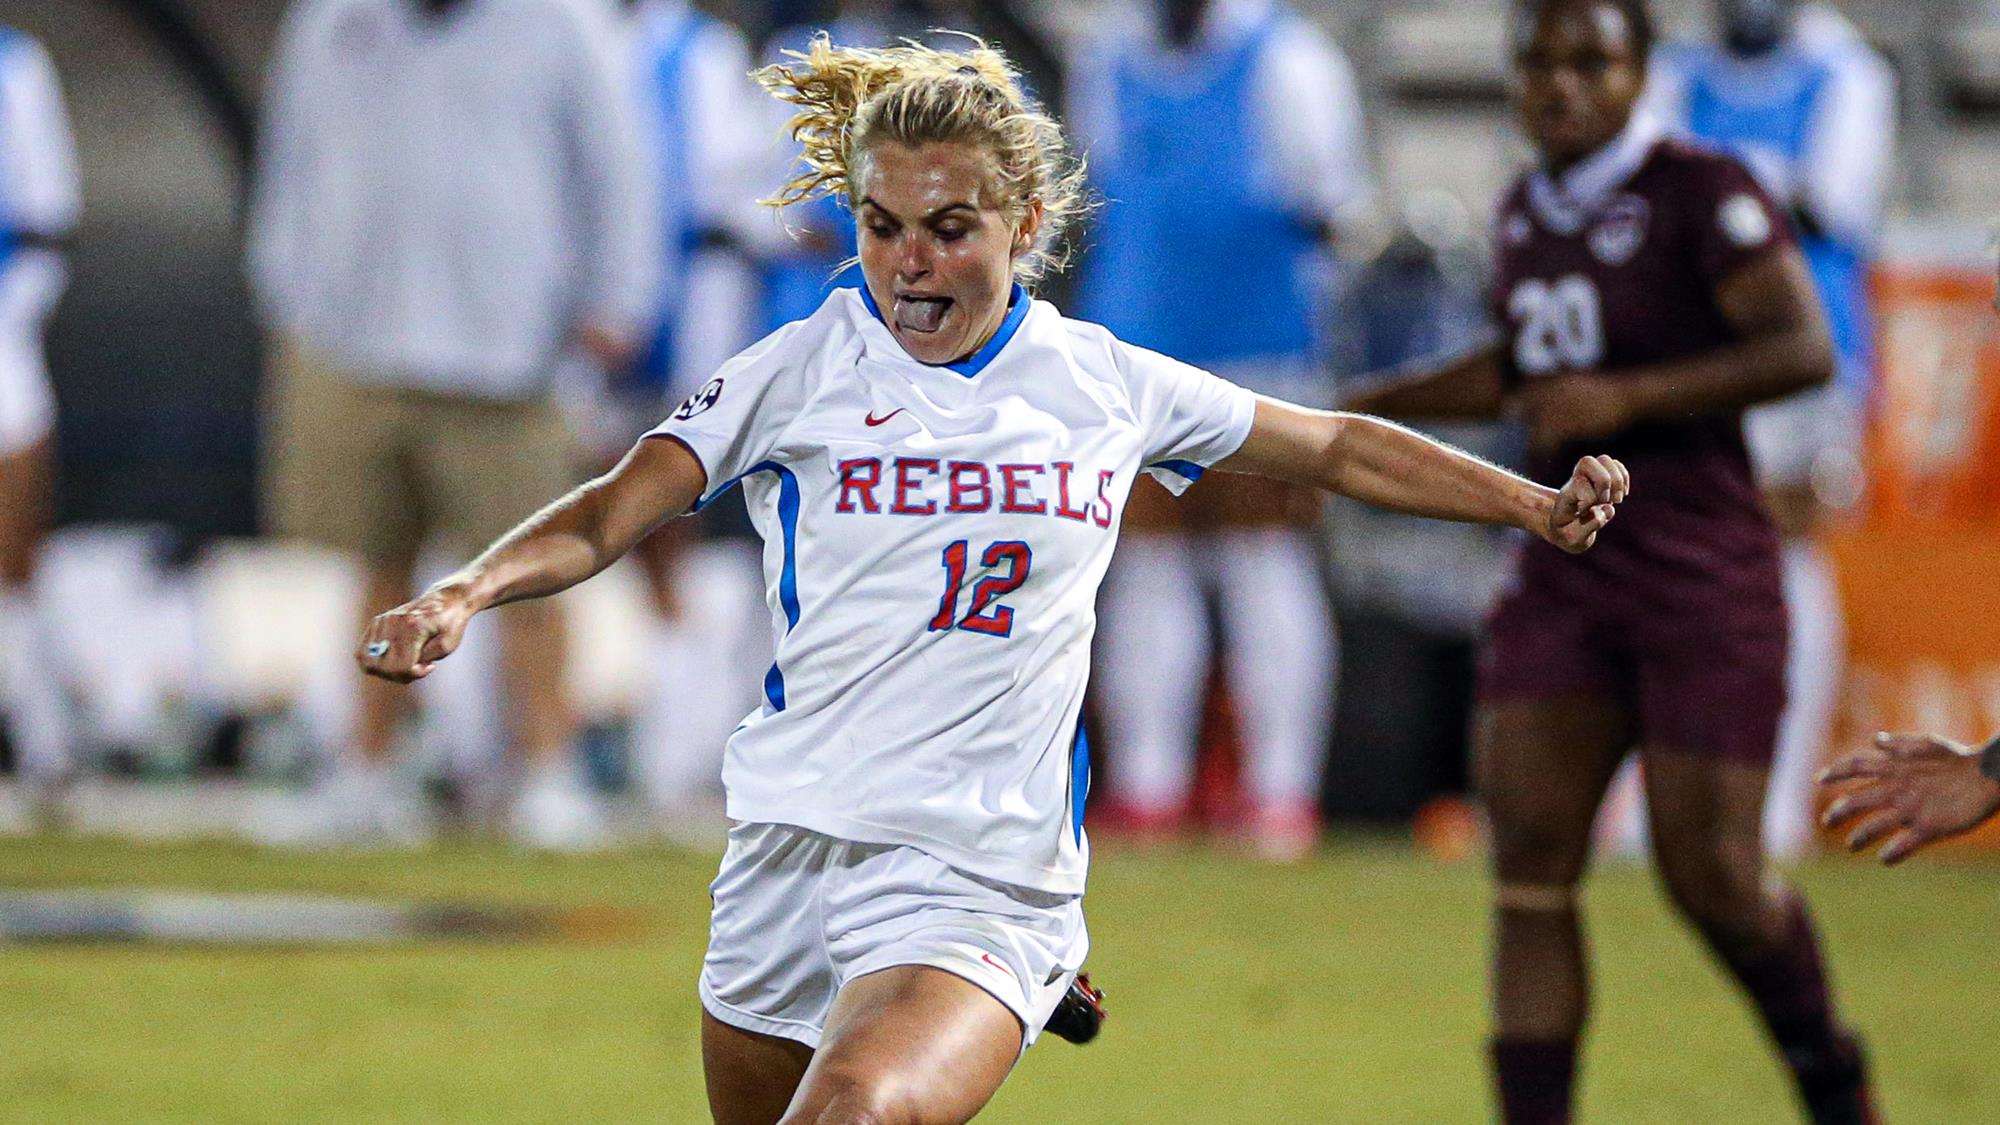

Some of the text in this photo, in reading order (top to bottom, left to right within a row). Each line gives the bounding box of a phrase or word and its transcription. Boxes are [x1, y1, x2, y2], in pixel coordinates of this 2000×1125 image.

[1508, 276, 1604, 372] 20
[835, 456, 1114, 529] REBELS
[928, 540, 1032, 638] 12
